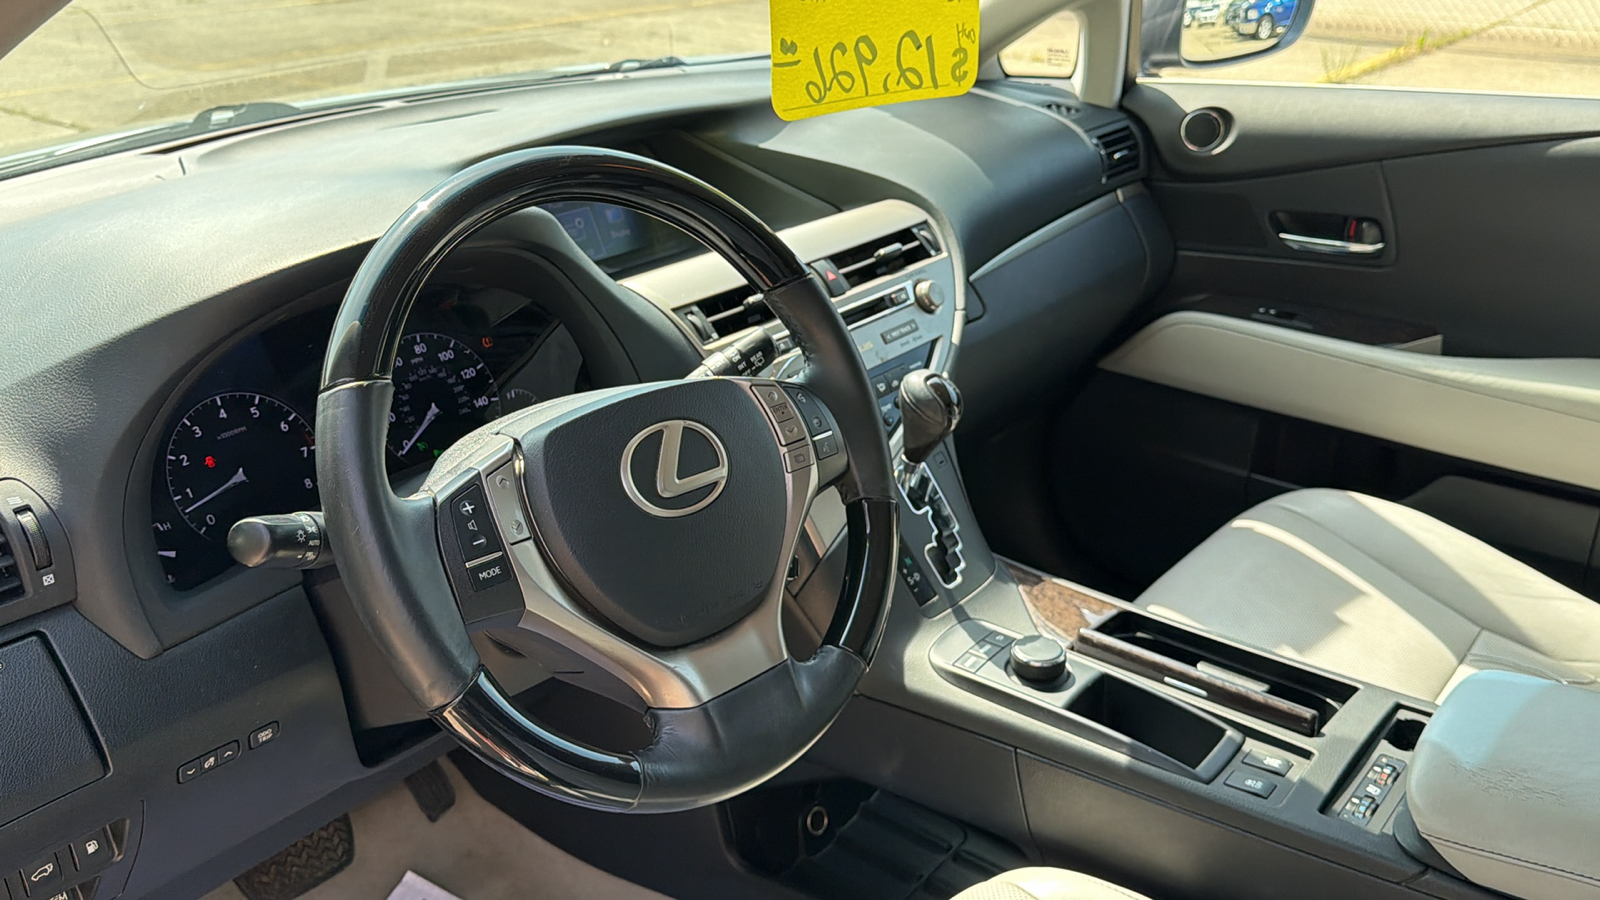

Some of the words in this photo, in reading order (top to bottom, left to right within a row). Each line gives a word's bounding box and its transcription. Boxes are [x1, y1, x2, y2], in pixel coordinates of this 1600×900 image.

[413, 343, 427, 354] 80
[438, 349, 455, 362] 100
[749, 350, 764, 363] REAR
[737, 361, 748, 371] INT
[460, 367, 476, 379] 120
[473, 395, 489, 409] 140
[218, 408, 228, 420] 4
[250, 406, 260, 419] 5
[772, 404, 788, 414] ENTER
[191, 425, 203, 438] 3
[280, 420, 289, 433] 6
[300, 446, 308, 458] 7
[179, 454, 190, 467] 2
[303, 478, 314, 490] 8
[185, 487, 194, 499] 1
[206, 513, 217, 526] 0
[163, 522, 173, 531] H
[308, 539, 321, 547] AUTO
[478, 565, 502, 581] MODE
